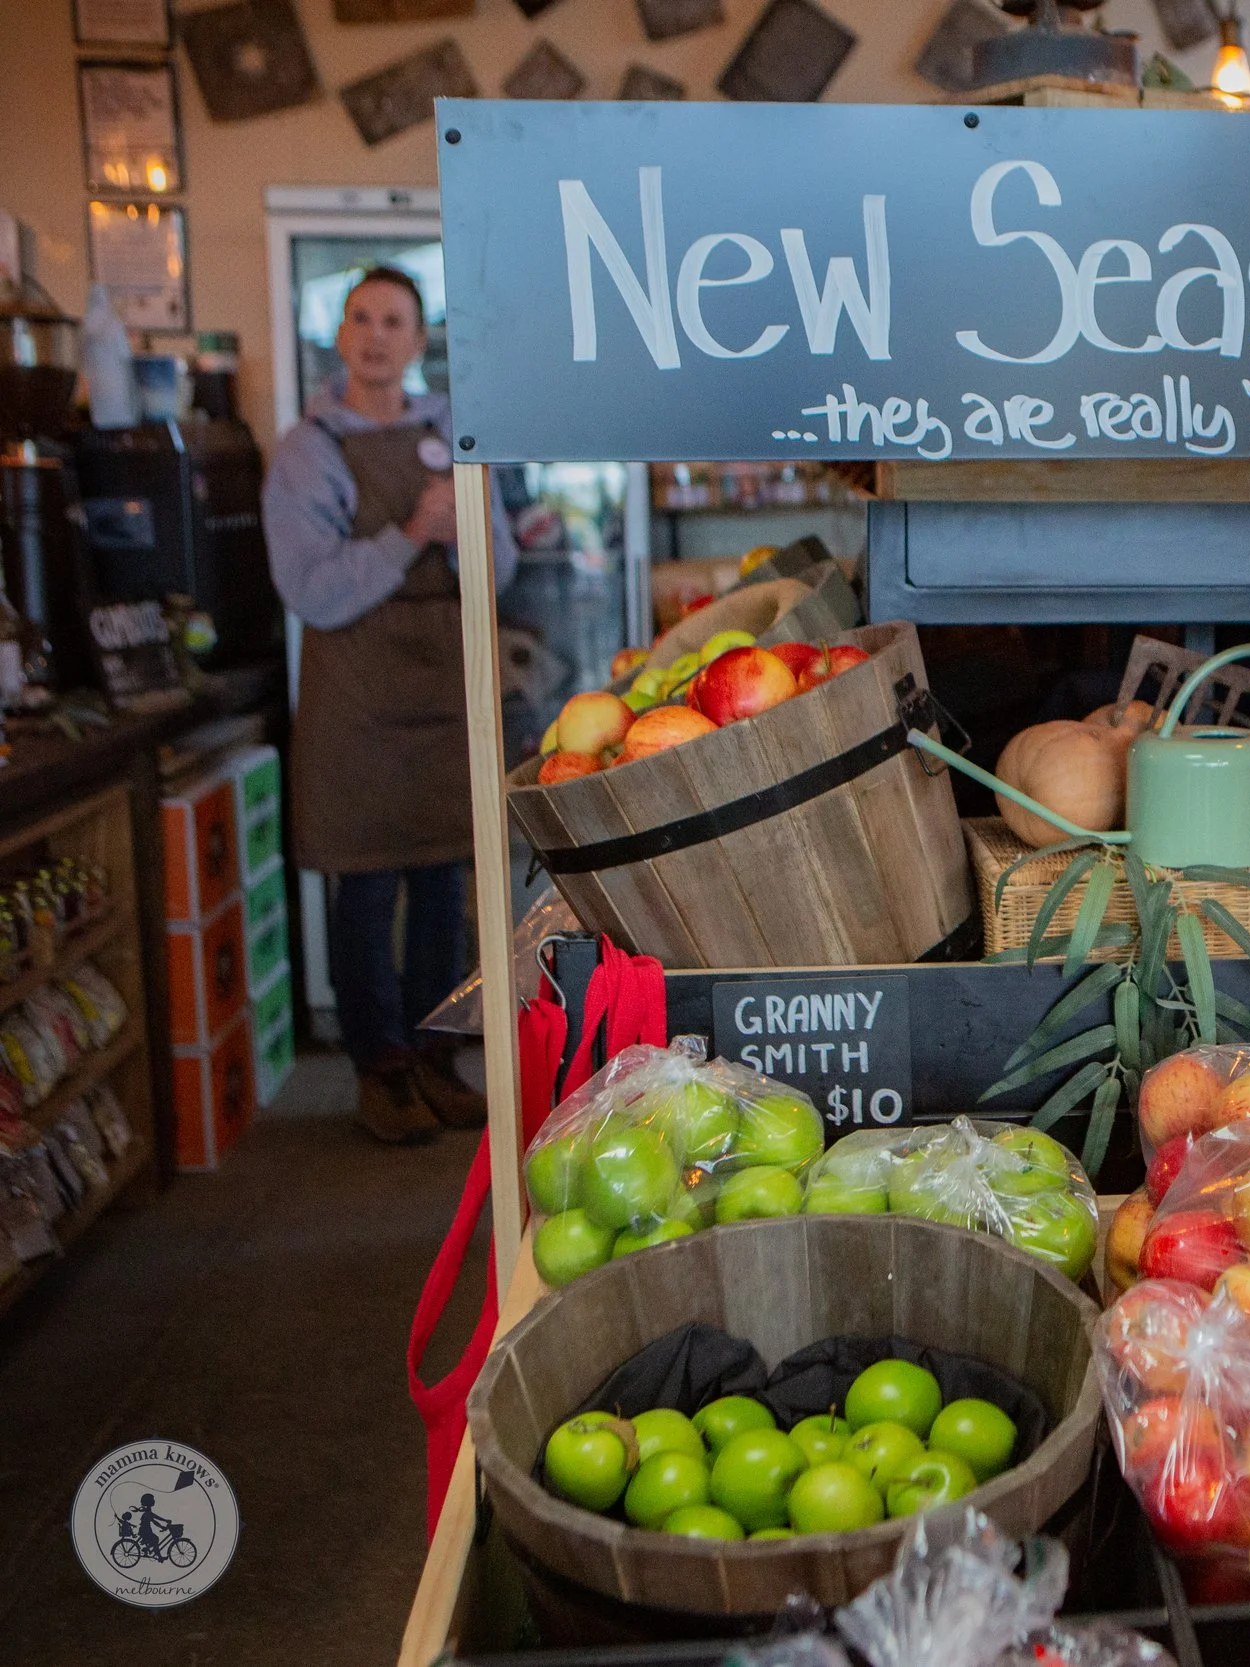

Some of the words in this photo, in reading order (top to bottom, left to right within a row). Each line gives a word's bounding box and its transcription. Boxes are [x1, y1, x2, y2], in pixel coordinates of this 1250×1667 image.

[558, 165, 892, 370] New
[960, 391, 1077, 450] are
[1080, 374, 1236, 456] really
[734, 990, 884, 1035] GRANNY
[740, 1040, 870, 1075] SMITH
[825, 1084, 904, 1127] $10
